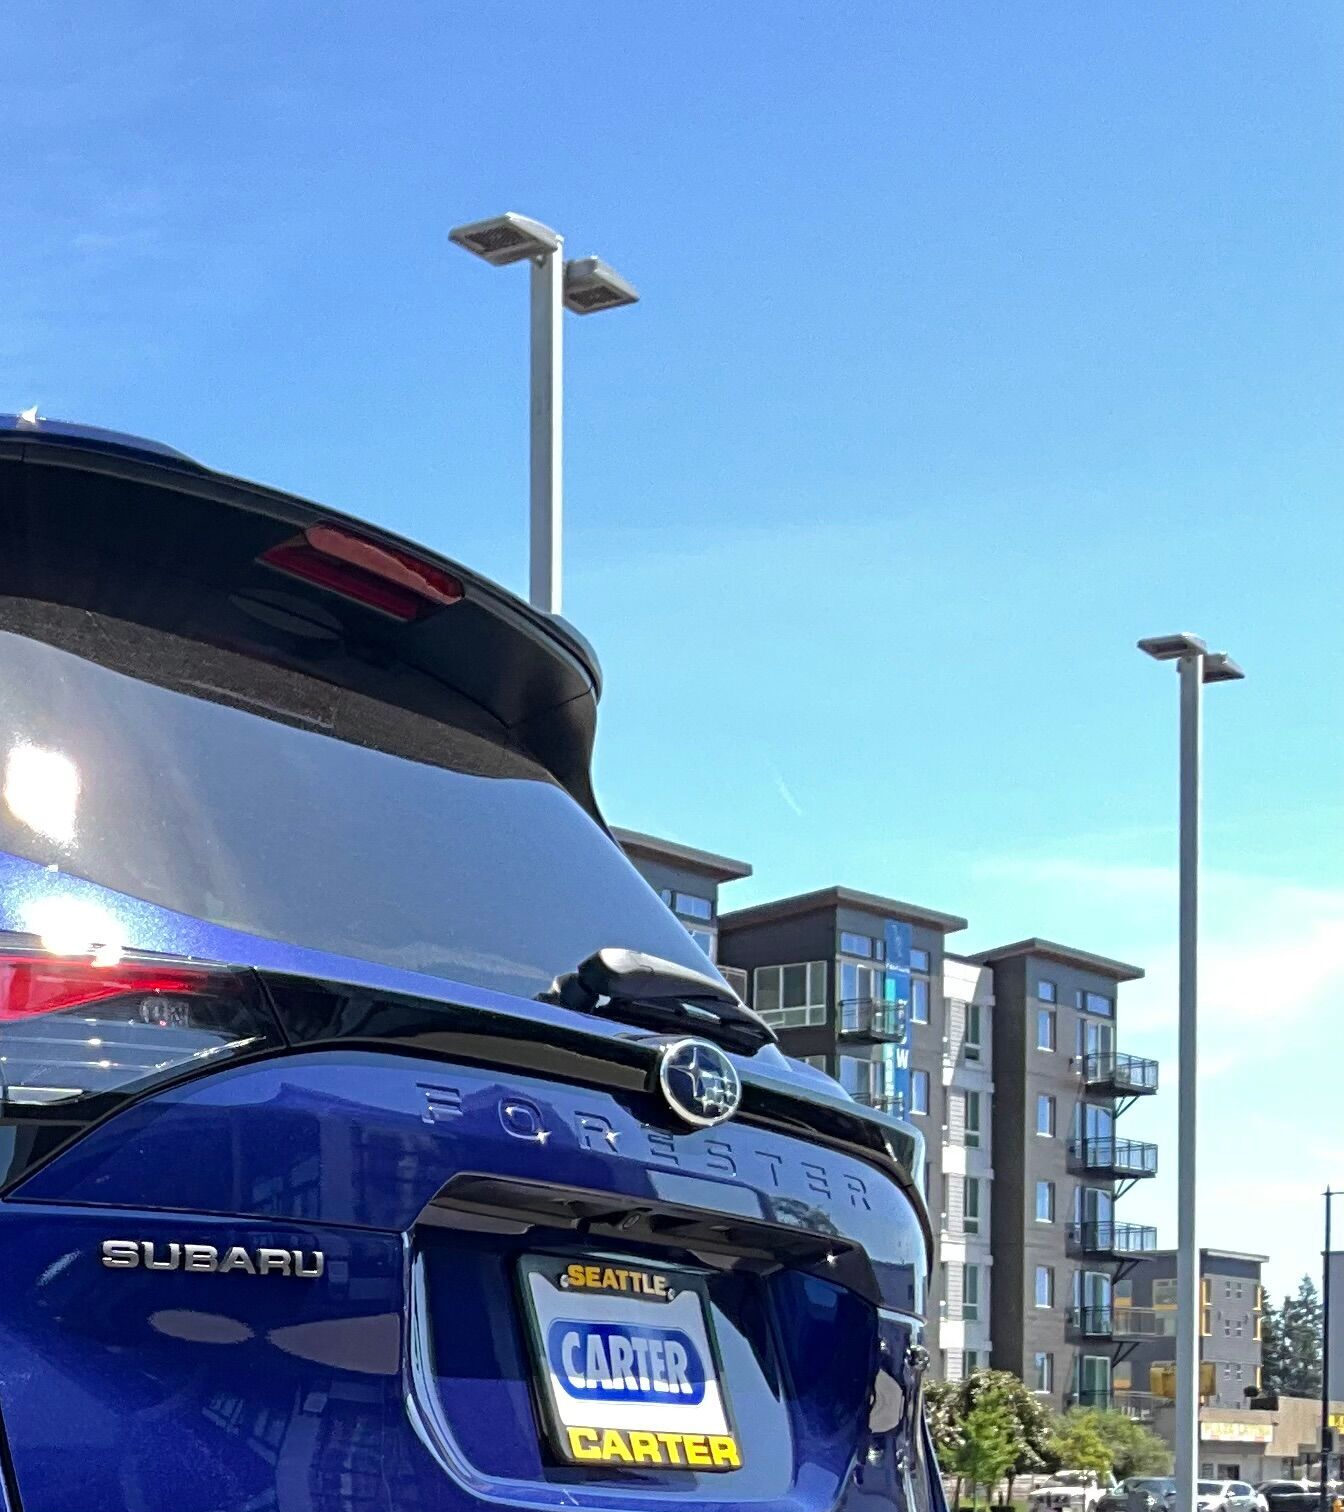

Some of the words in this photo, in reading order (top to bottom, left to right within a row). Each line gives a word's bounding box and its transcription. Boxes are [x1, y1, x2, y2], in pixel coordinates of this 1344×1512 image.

[415, 1082, 873, 1212] FORESTER
[101, 1239, 325, 1278] SUBARU
[566, 1264, 668, 1297] SEATTLE
[561, 1331, 694, 1395] CARTER
[566, 1426, 741, 1466] CARTER
